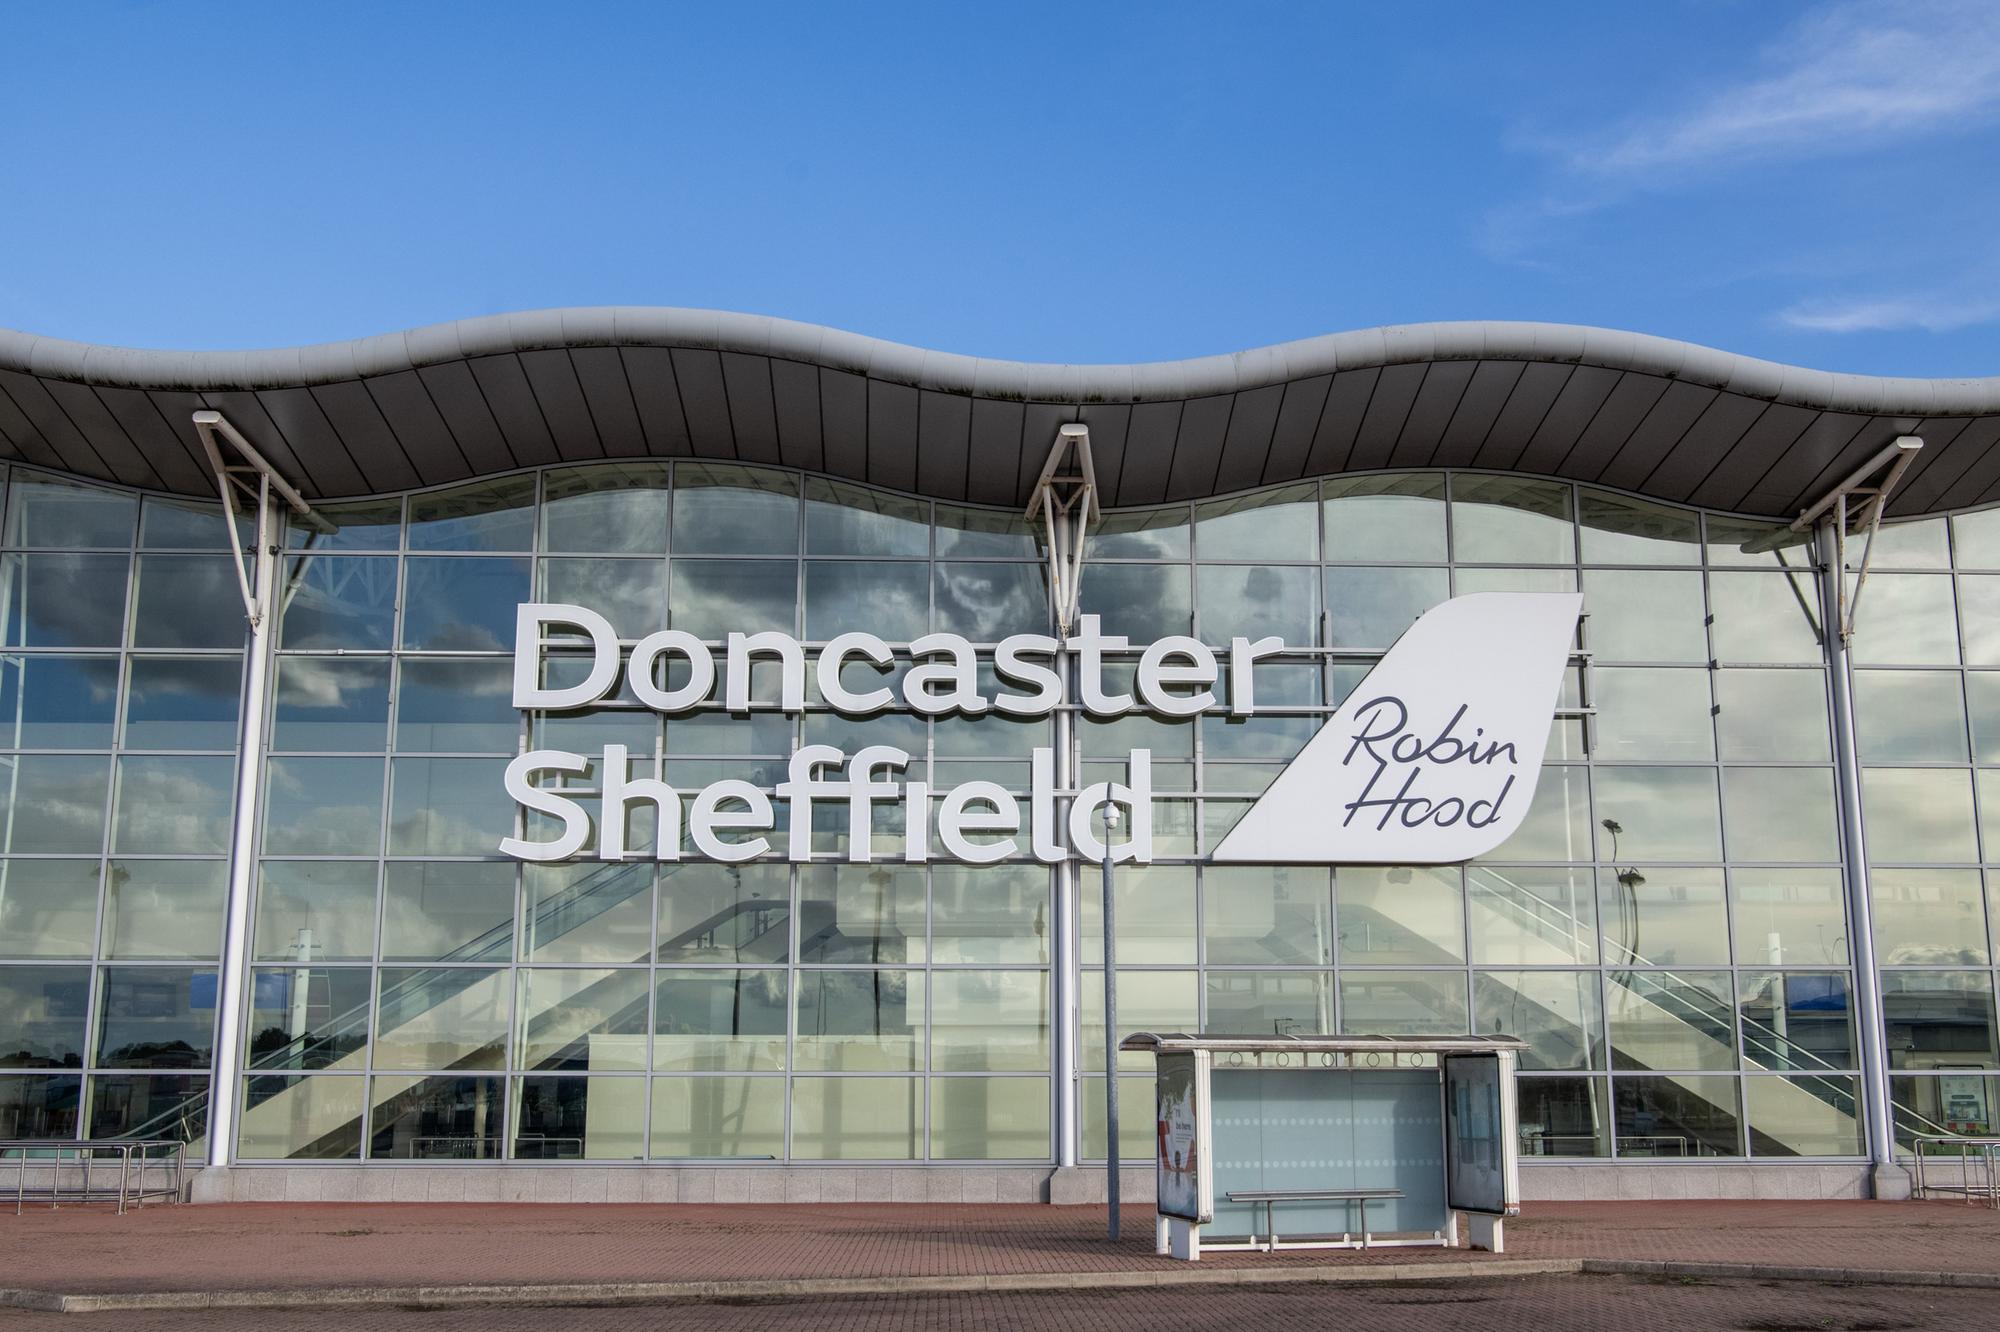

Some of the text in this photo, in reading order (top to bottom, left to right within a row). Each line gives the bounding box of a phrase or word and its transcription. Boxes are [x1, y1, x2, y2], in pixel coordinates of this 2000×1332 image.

[512, 603, 1284, 716] Doncaster
[1343, 696, 1518, 766] Robin
[499, 744, 1153, 864] Sheffield
[1343, 763, 1515, 831] Hood
